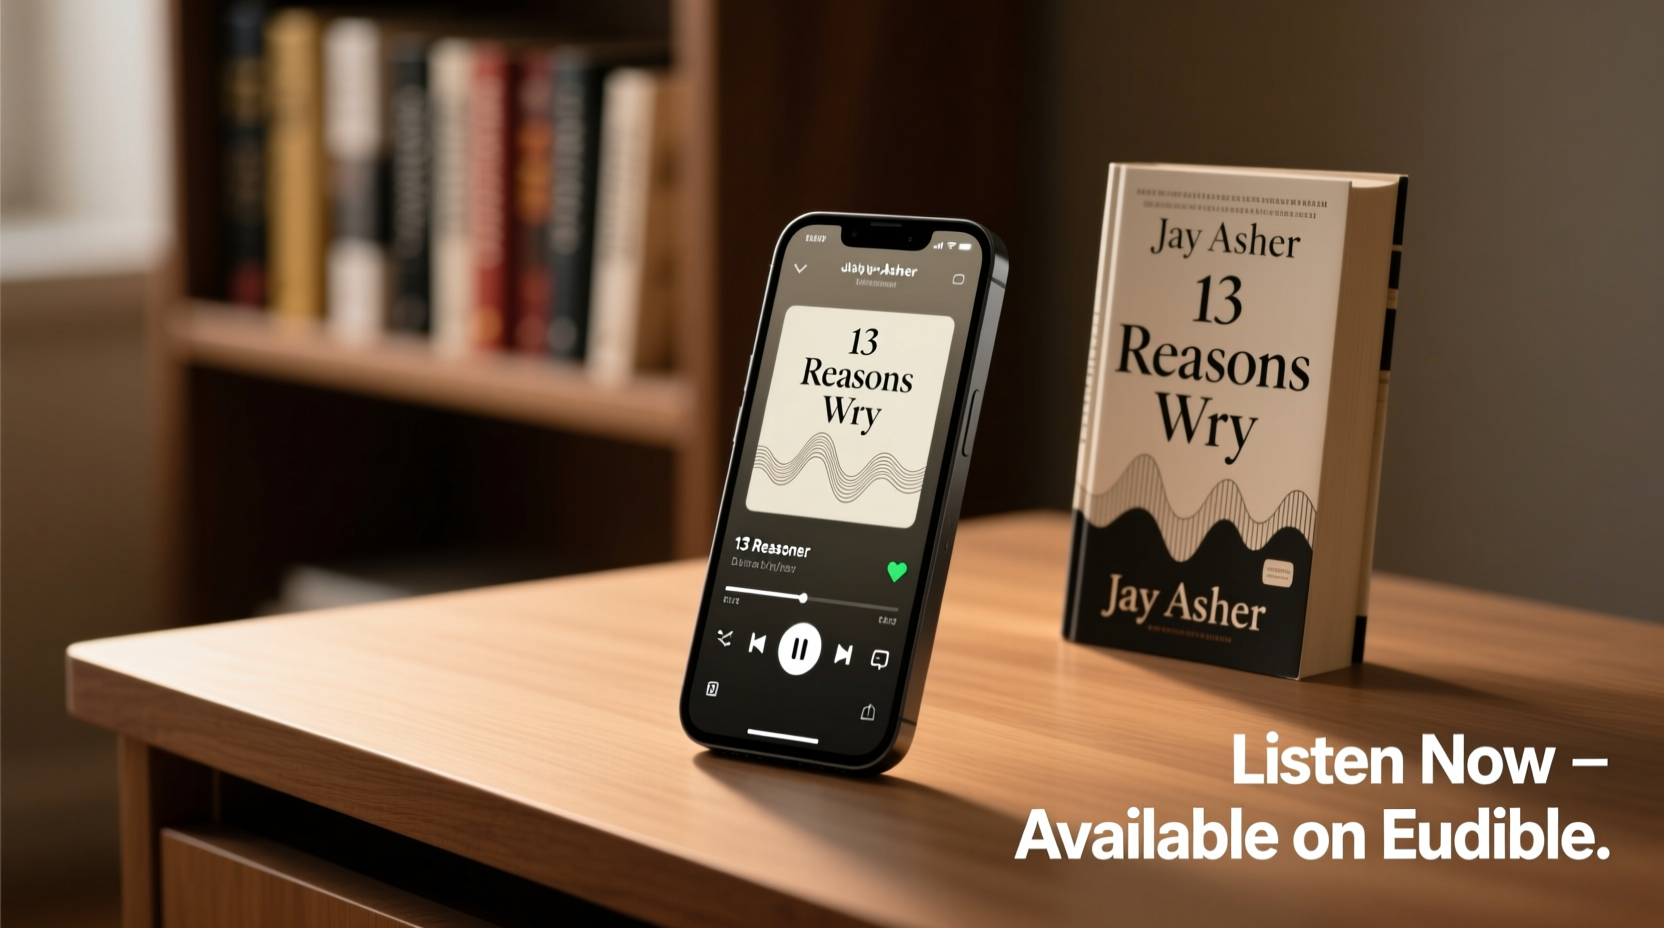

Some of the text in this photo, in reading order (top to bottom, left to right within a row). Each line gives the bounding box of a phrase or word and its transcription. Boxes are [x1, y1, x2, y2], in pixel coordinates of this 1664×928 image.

[1150, 217, 1301, 259] Jay Asher
[1193, 275, 1242, 325] 13
[848, 328, 879, 356] 13
[1115, 322, 1311, 393] Reasons
[800, 356, 914, 394] Reasons
[823, 395, 882, 436] Wry
[1155, 391, 1259, 466] Wry
[735, 536, 751, 552] 13
[1100, 572, 1267, 632] Jay Asher
